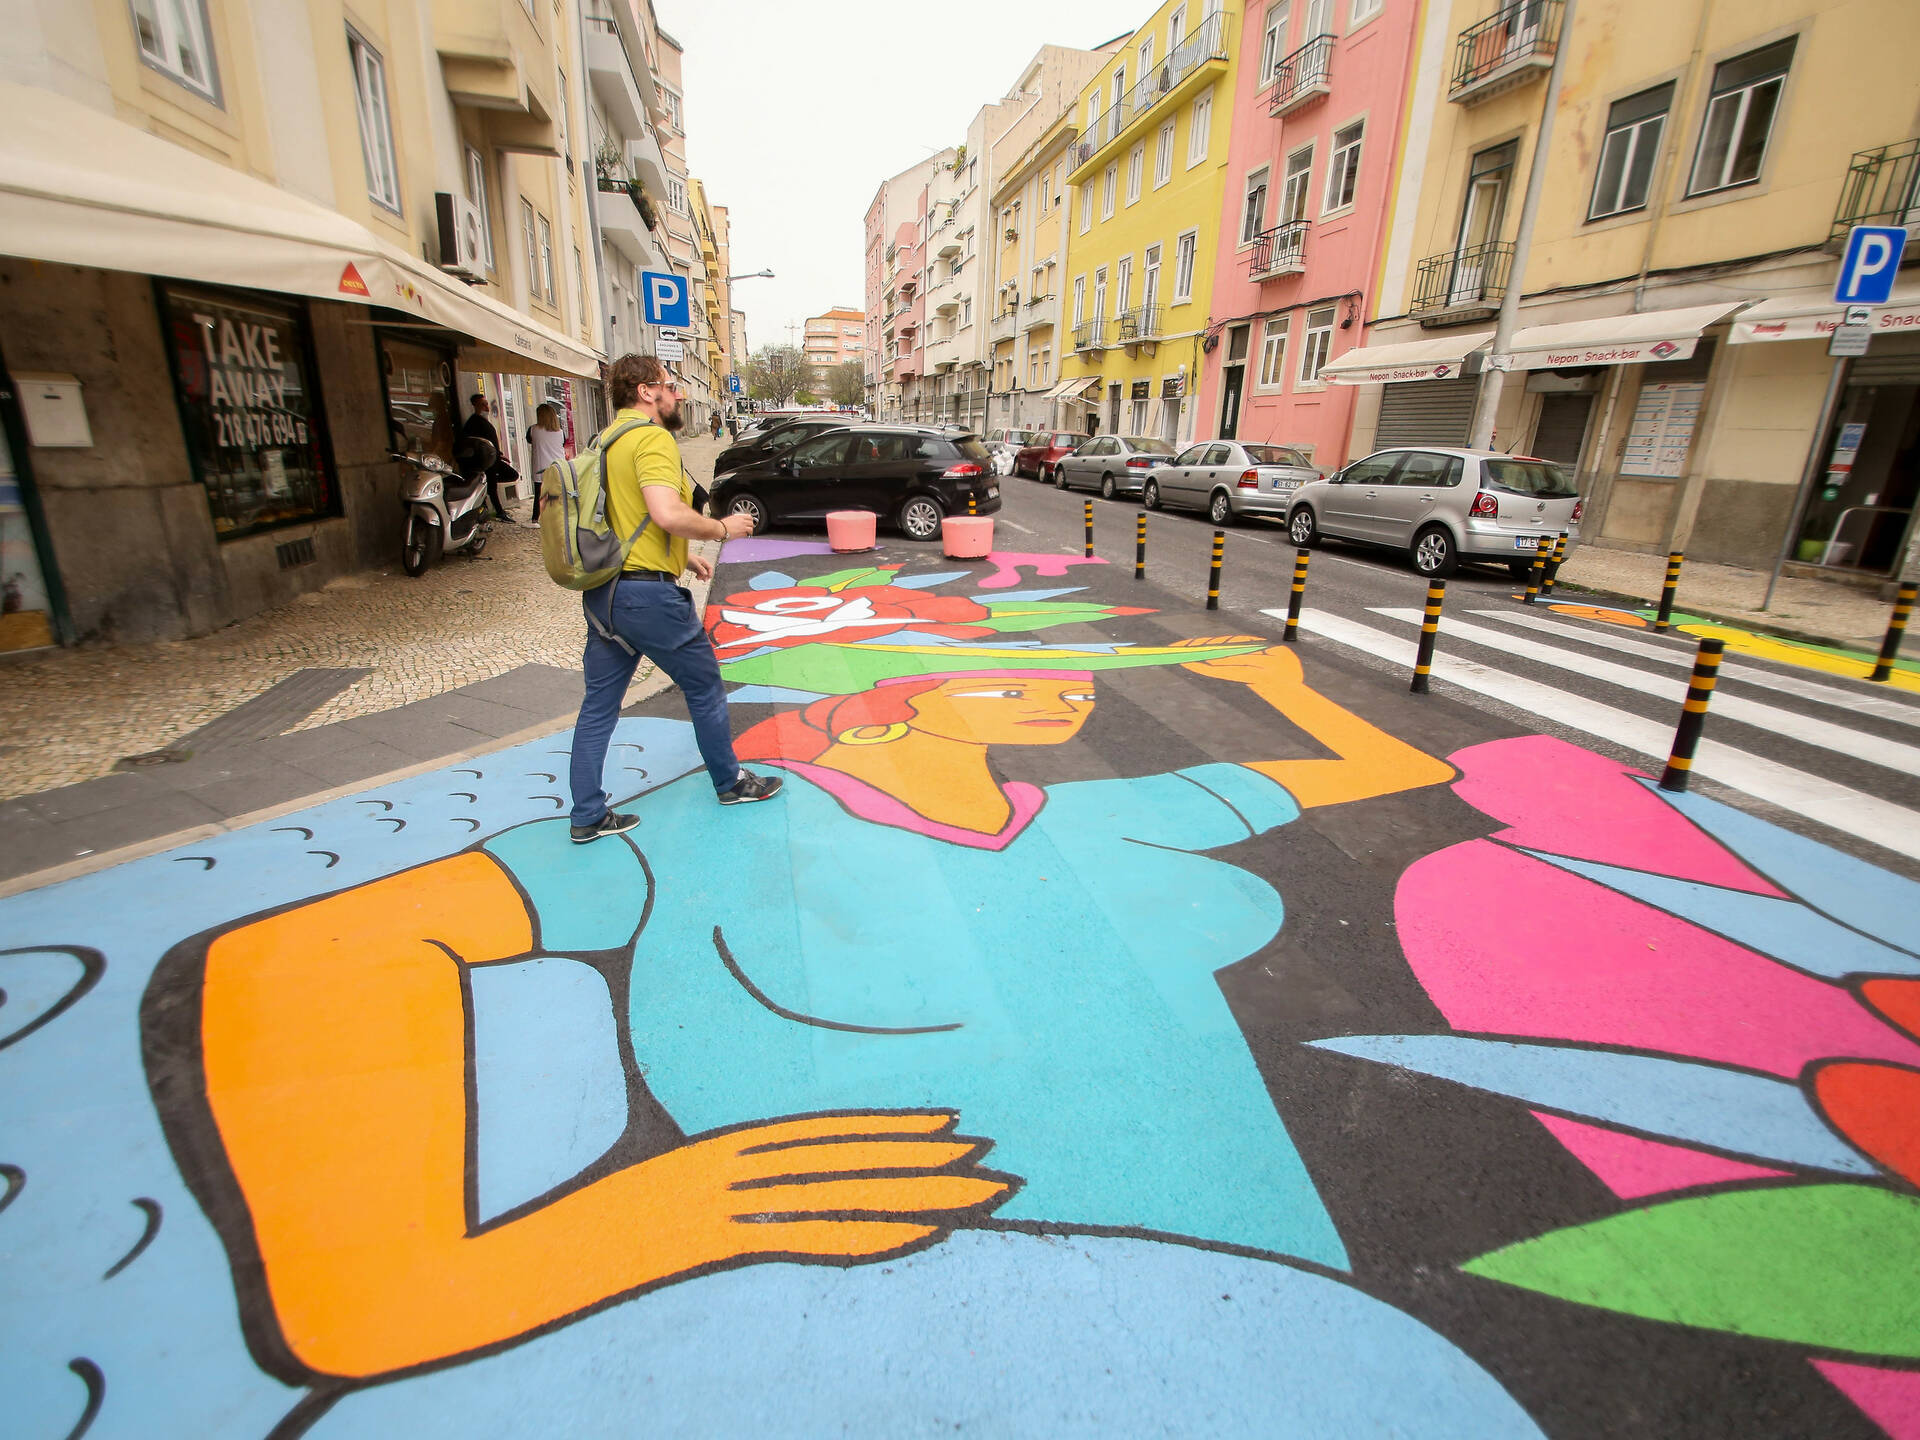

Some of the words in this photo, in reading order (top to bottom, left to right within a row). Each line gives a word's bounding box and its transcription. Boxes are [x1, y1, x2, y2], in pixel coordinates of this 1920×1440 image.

[1846, 234, 1891, 297] P
[651, 277, 680, 320] P
[192, 313, 283, 371] TAKE
[1546, 354, 1579, 366] Nepon
[1584, 349, 1641, 362] Snack-bar
[210, 369, 285, 408] AWAY
[731, 379, 738, 390] P
[1369, 373, 1390, 382] Nepon
[1393, 369, 1428, 380] Snack-bar
[213, 413, 245, 447] 218
[246, 413, 272, 446] 476
[272, 413, 296, 445] 694
